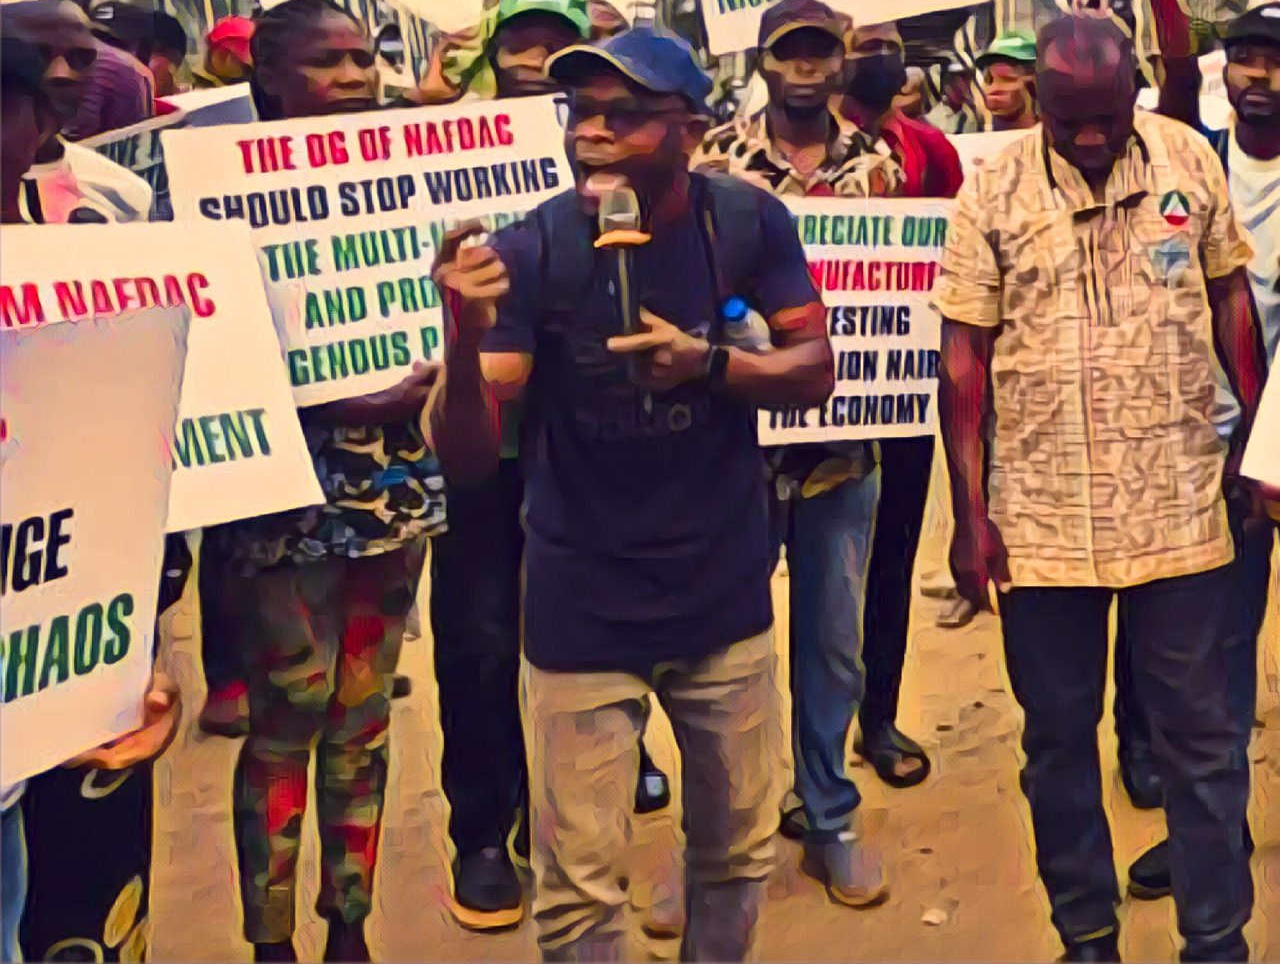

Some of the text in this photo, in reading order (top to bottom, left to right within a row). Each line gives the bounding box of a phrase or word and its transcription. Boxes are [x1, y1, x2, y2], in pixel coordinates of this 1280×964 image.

[237, 113, 514, 174] THE DG OF NAFDAC
[338, 174, 416, 216] STOP
[424, 156, 560, 204] WORKING
[795, 215, 948, 248] RECIATE OUR
[261, 239, 322, 282] THE
[53, 272, 216, 322] NAFDAC
[305, 286, 366, 329] AND
[288, 331, 412, 387] GENOUS
[0, 593, 134, 703] HAOS
